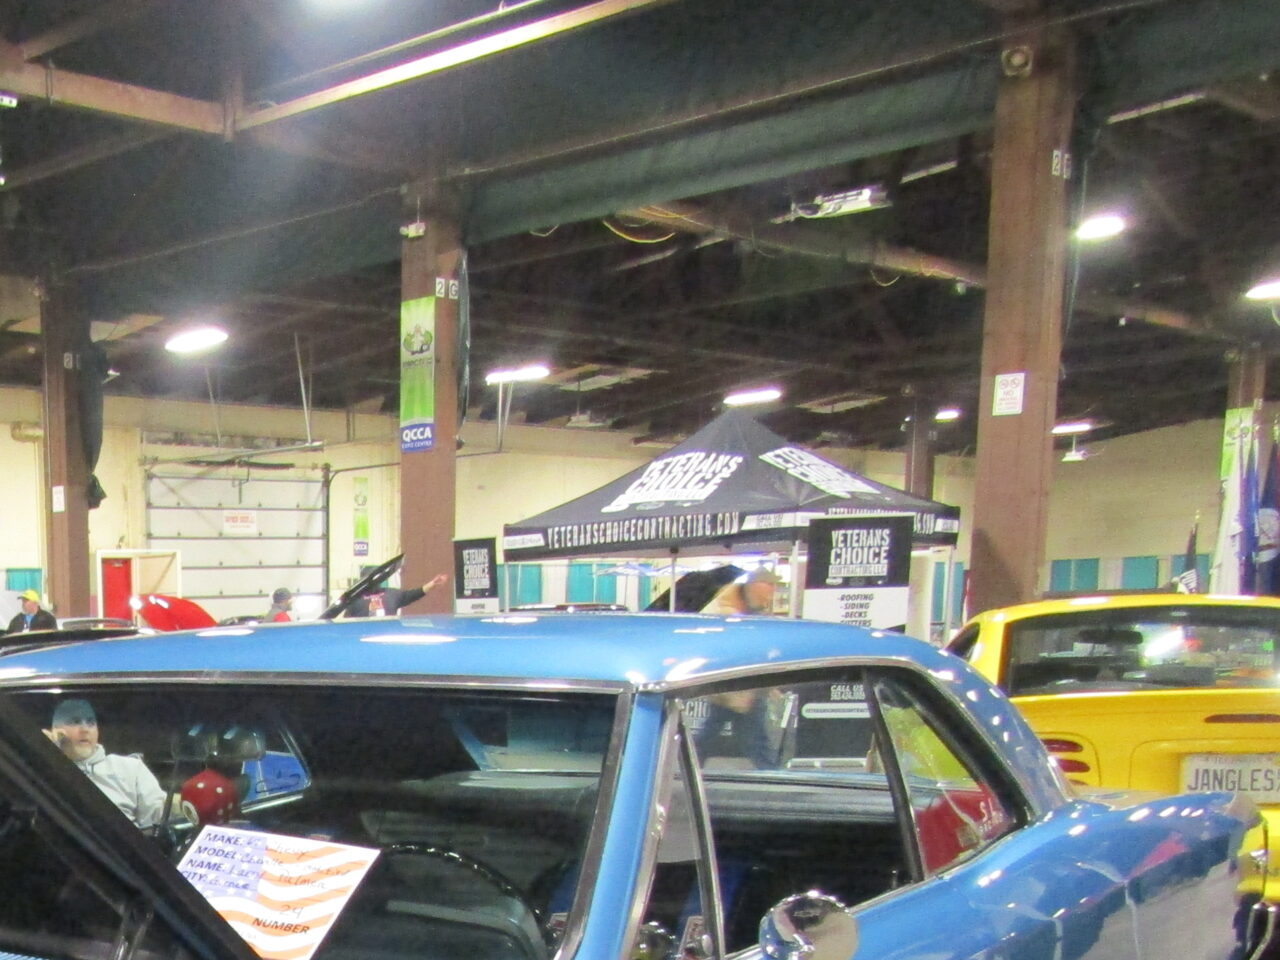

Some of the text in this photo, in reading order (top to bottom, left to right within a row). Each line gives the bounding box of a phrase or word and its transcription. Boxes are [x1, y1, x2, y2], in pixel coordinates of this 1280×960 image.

[402, 426, 433, 442] QCCA
[640, 452, 744, 480] VETERANS
[624, 471, 723, 496] CHOICE
[547, 511, 740, 549] VETERANSCHOICECONTRACTING.COM
[831, 528, 890, 548] VETERANS
[830, 547, 890, 566] CHOICE
[1187, 767, 1280, 792] JANGLES
[252, 917, 310, 935] NUMBER
